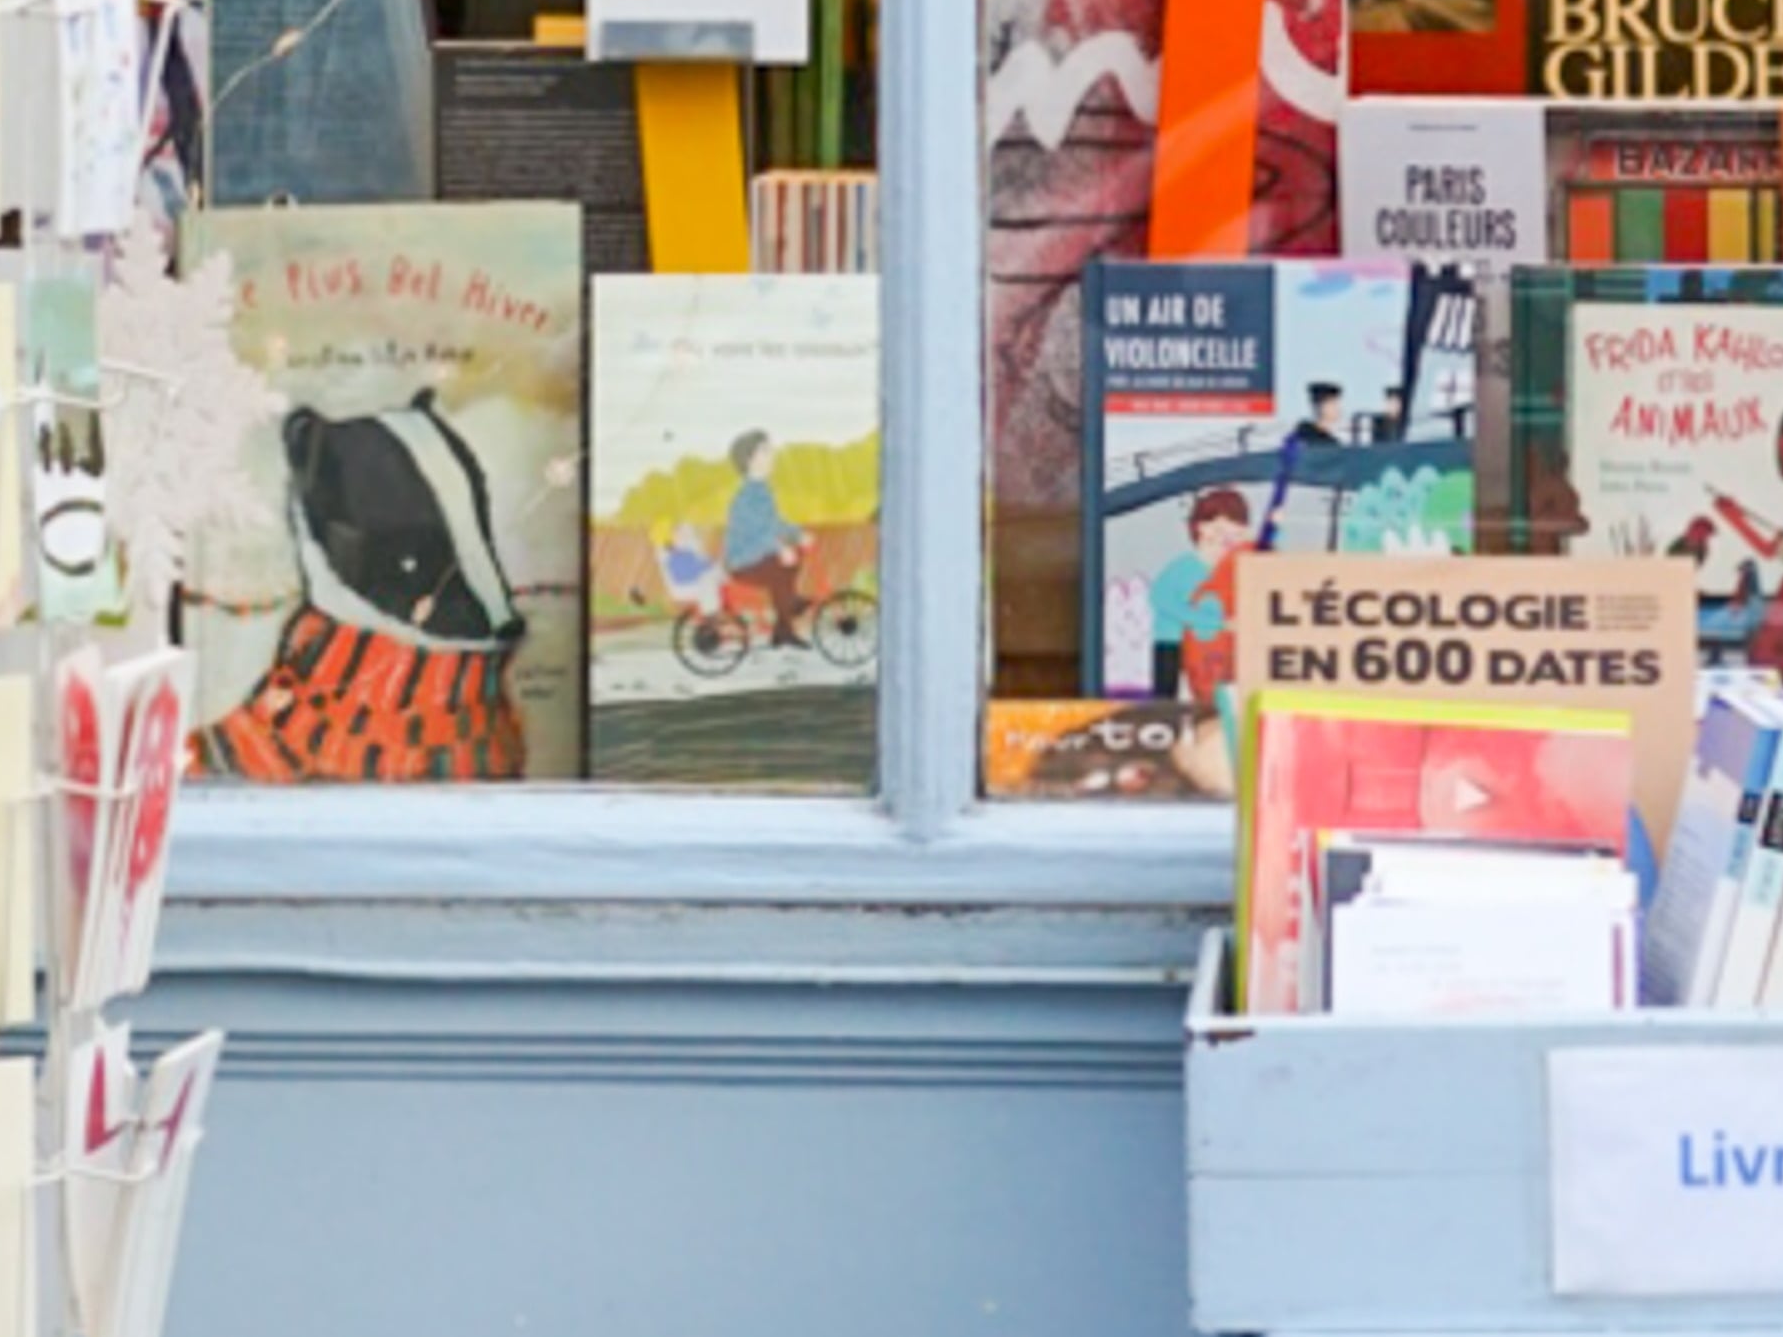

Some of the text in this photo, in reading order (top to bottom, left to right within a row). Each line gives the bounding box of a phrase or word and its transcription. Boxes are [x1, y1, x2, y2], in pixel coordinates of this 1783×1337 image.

[1405, 164, 1487, 205] PARIS
[1376, 207, 1517, 250] COULEURS
[1106, 295, 1224, 327] UN AIR DE
[1104, 337, 1257, 369] VIOLONCELLE
[1584, 327, 1675, 371] FRIDA
[1608, 396, 1767, 447] ANIMAUX
[1268, 580, 1589, 630] L'ÉCOLOGIE
[1268, 638, 1662, 686] EN 600 DATES
